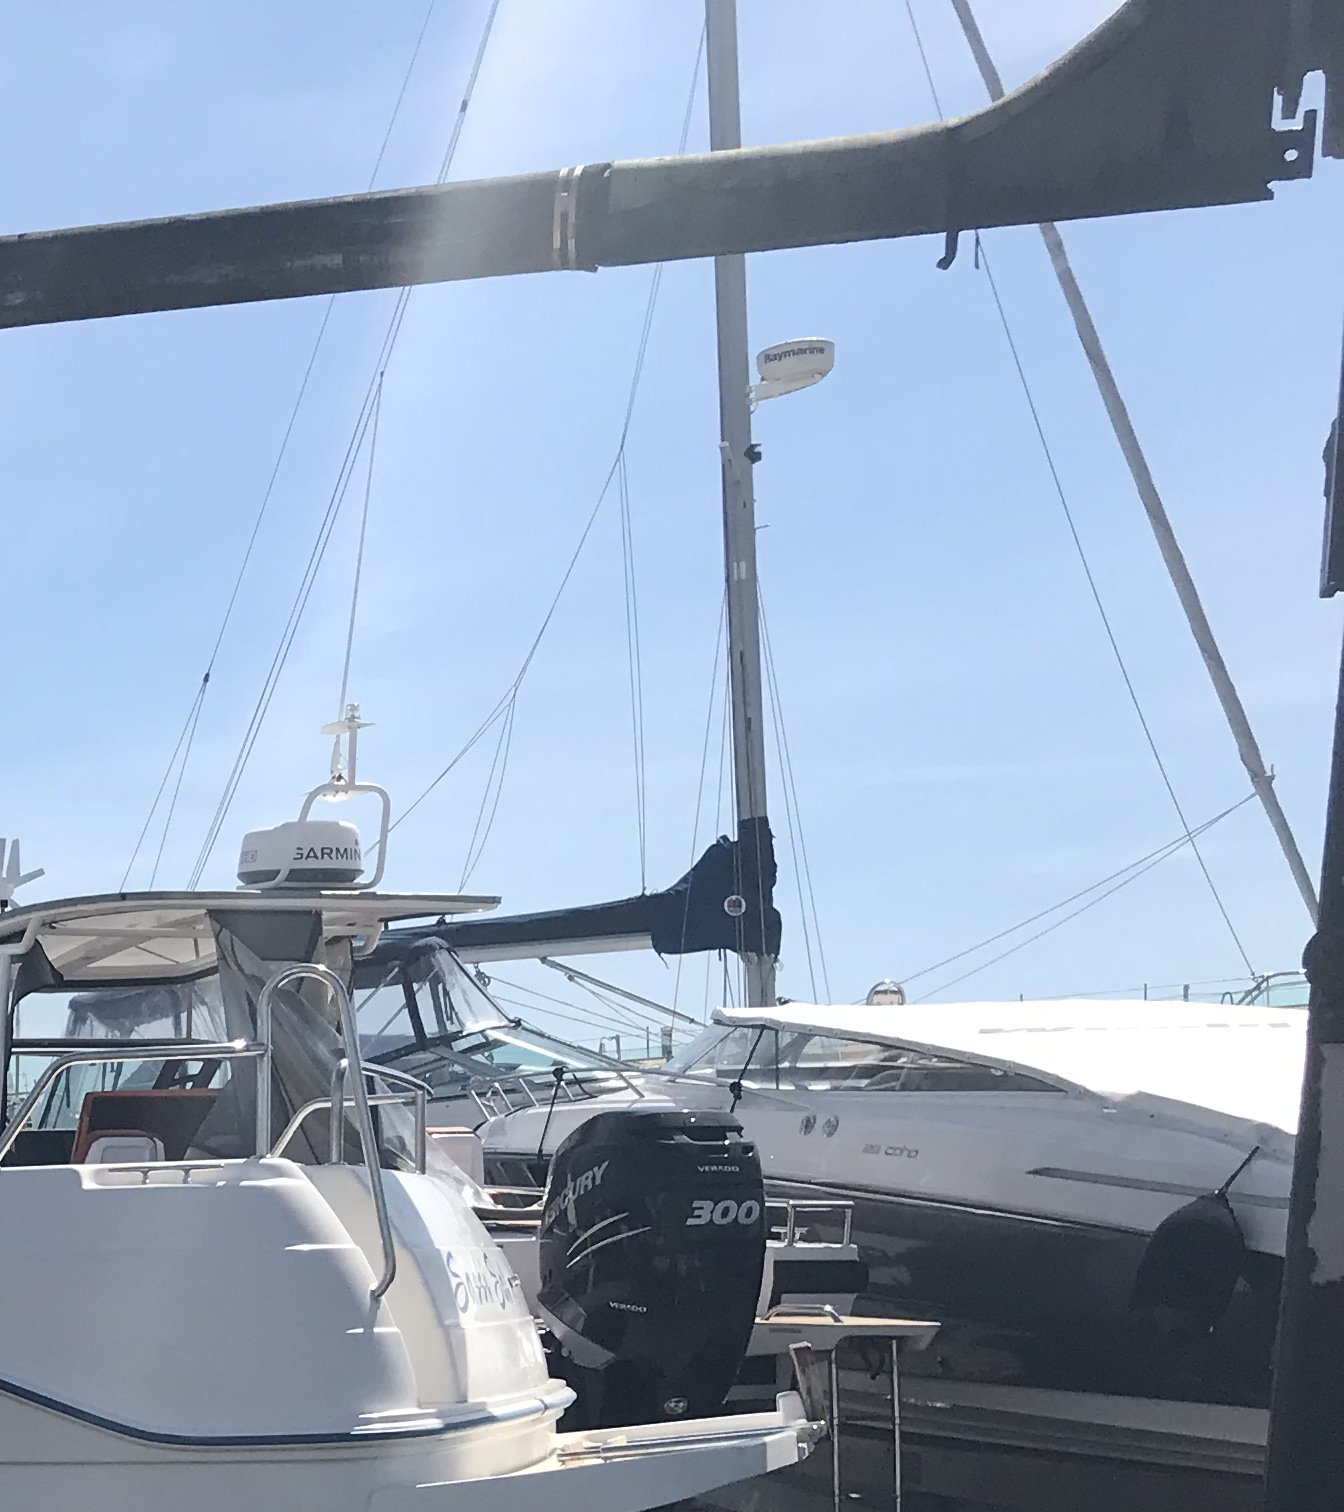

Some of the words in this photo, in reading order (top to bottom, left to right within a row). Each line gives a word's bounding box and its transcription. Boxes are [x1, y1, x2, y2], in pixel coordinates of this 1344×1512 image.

[764, 346, 825, 364] Raymarine
[293, 847, 361, 860] GARMIN
[686, 1200, 760, 1225] 300
